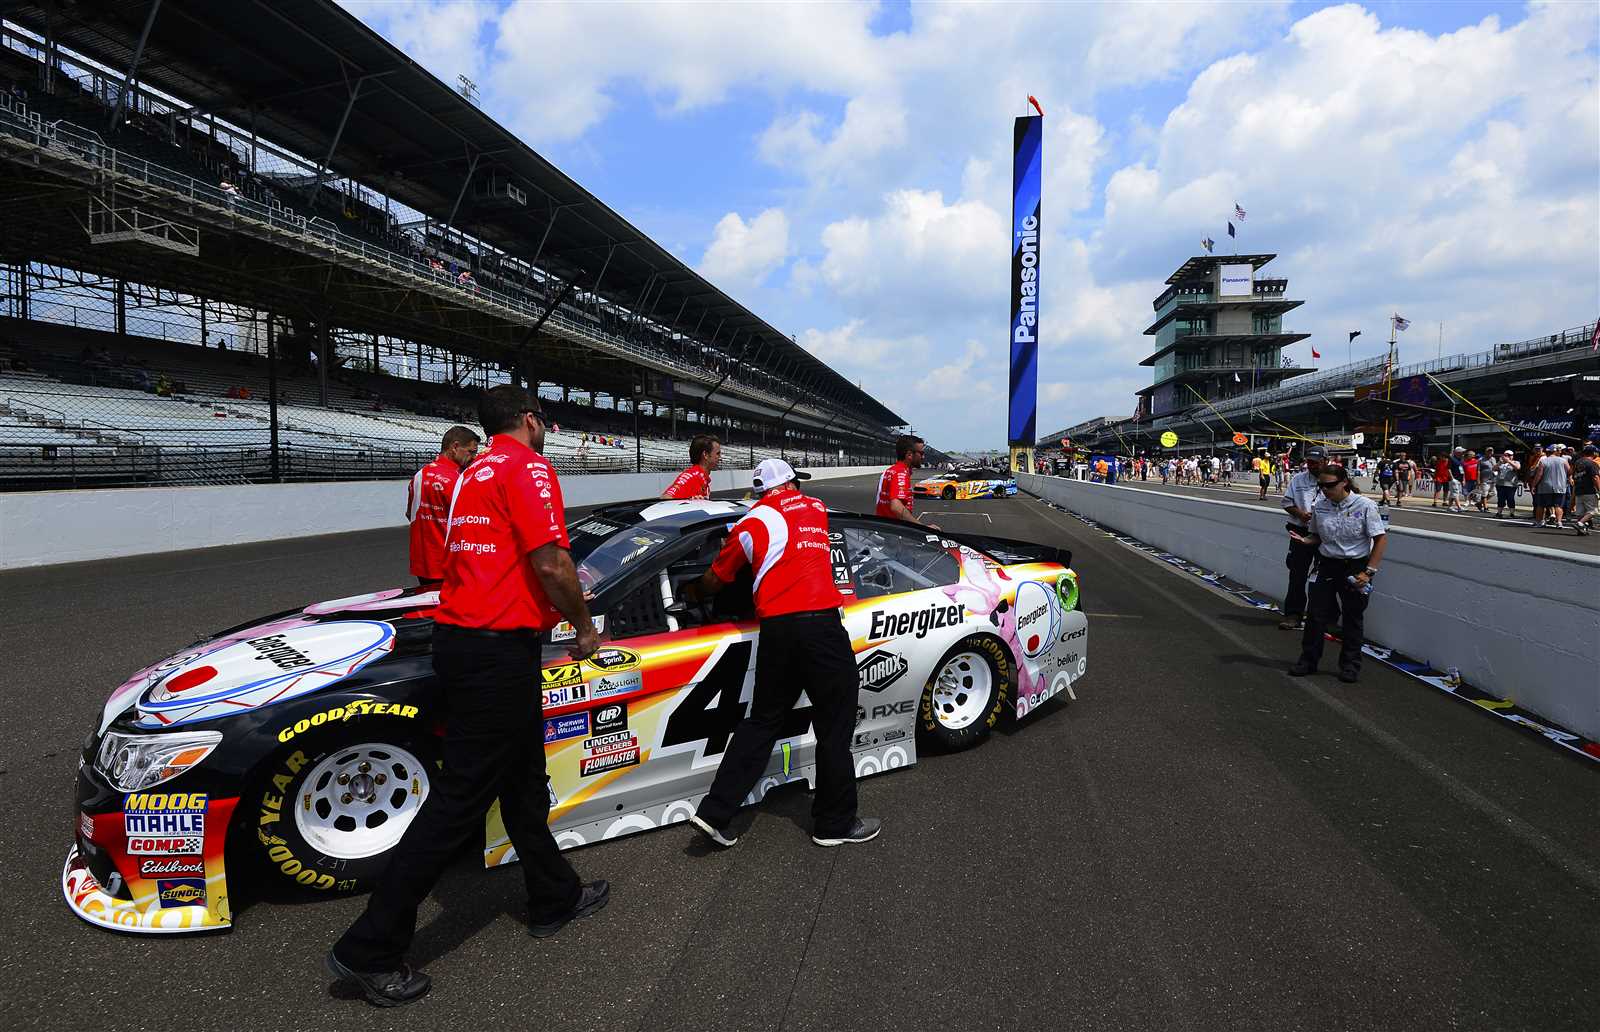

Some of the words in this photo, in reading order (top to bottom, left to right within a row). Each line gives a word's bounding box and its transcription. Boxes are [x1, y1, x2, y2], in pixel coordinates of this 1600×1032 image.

[1014, 215, 1038, 344] Panasonic
[867, 602, 966, 641] Energizer
[1017, 603, 1049, 631] Energizer
[1060, 627, 1086, 642] Crest
[246, 634, 316, 672] Energizer
[603, 655, 623, 665] Sprint
[1057, 652, 1078, 667] belkin
[619, 677, 640, 687] LIGHT
[872, 700, 915, 720] AXE
[278, 700, 419, 743] GOODYEAR
[558, 718, 585, 728] SHERWIN
[585, 732, 628, 748] LINCOLN
[595, 740, 633, 754] WELDERS
[583, 750, 636, 775] FLOWMASTER
[124, 793, 207, 811] MOOG
[126, 814, 203, 832] MAHLE
[258, 750, 335, 890] GOODYEAR
[130, 838, 186, 852] COMP
[141, 860, 204, 874] Edelbrock
[162, 889, 205, 899] SUNOCO
